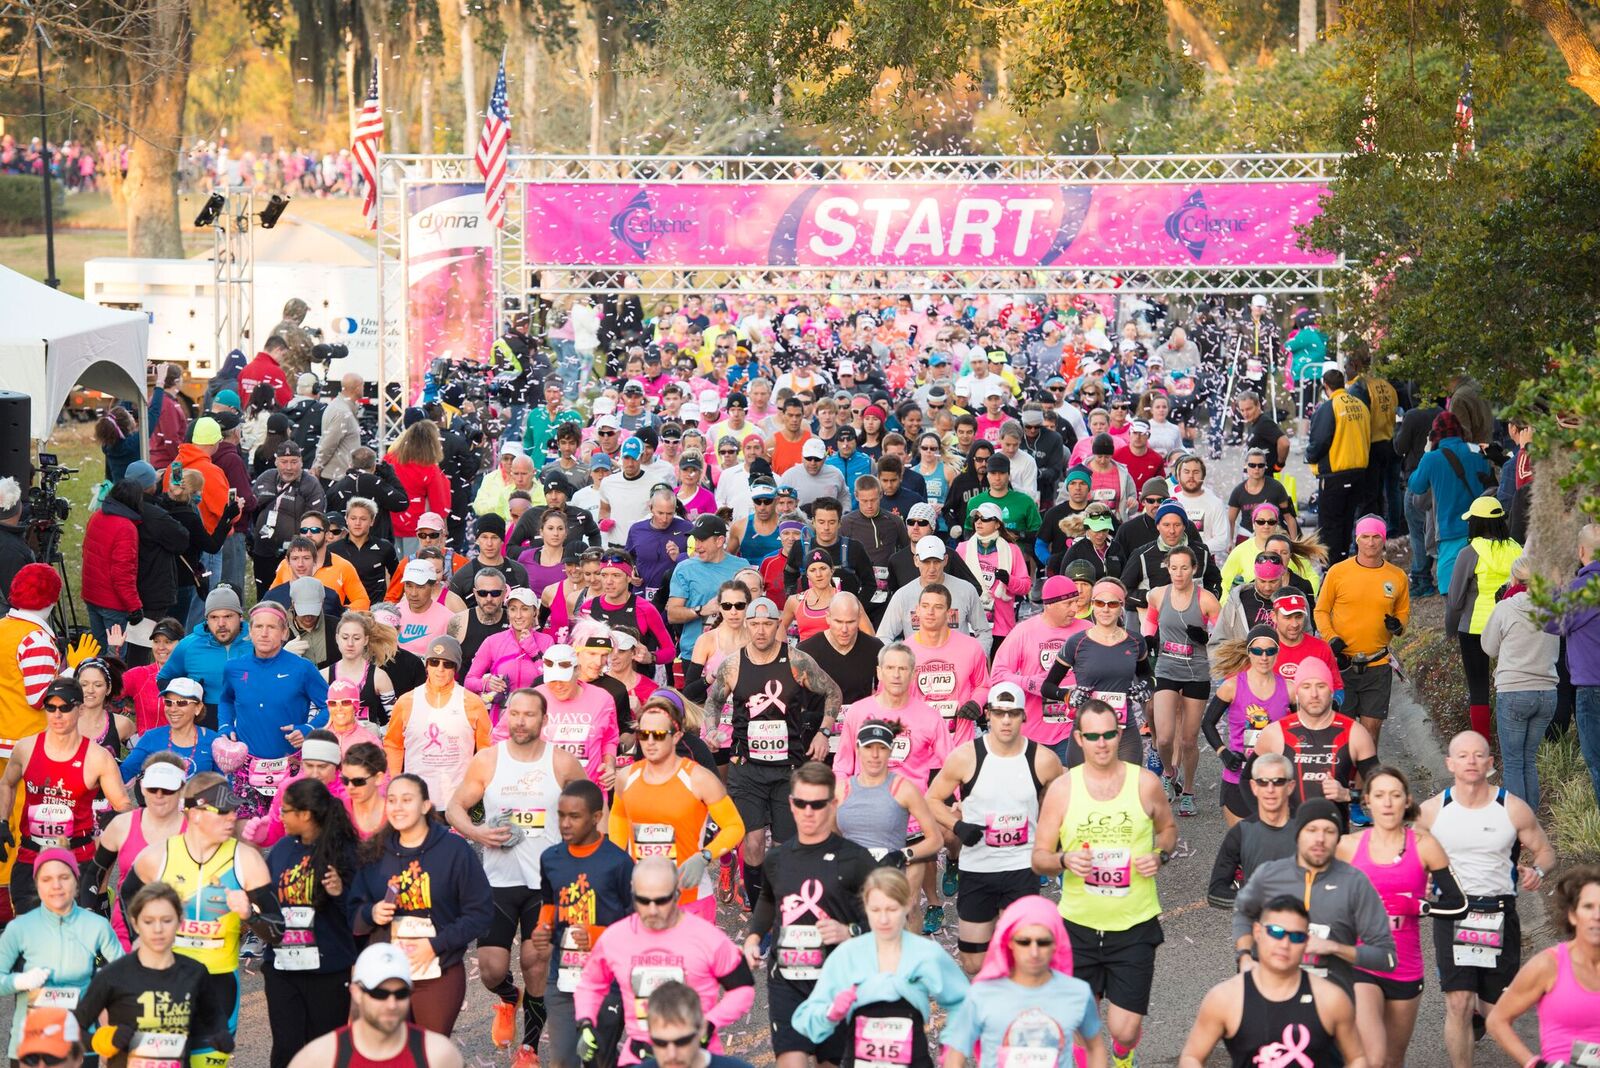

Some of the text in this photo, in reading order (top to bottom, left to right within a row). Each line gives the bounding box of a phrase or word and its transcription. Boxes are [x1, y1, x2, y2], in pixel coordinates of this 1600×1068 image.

[628, 214, 694, 236] Celgene
[809, 197, 1054, 257] START
[1183, 213, 1249, 237] Celgene
[404, 624, 428, 635] RUN
[915, 663, 955, 673] FINISHER
[547, 712, 592, 724] MAYO
[751, 739, 785, 750] 6010
[265, 775, 274, 784] 3
[515, 812, 533, 824] 19
[38, 825, 65, 836] 118
[1076, 826, 1133, 834] MOXIE
[995, 831, 1021, 844] 104
[638, 845, 673, 857] 1527
[1092, 871, 1123, 884] 103
[179, 922, 223, 936] 1537
[1457, 930, 1501, 947] 4912
[630, 955, 684, 967] FINISHER
[865, 1043, 900, 1059] 215
